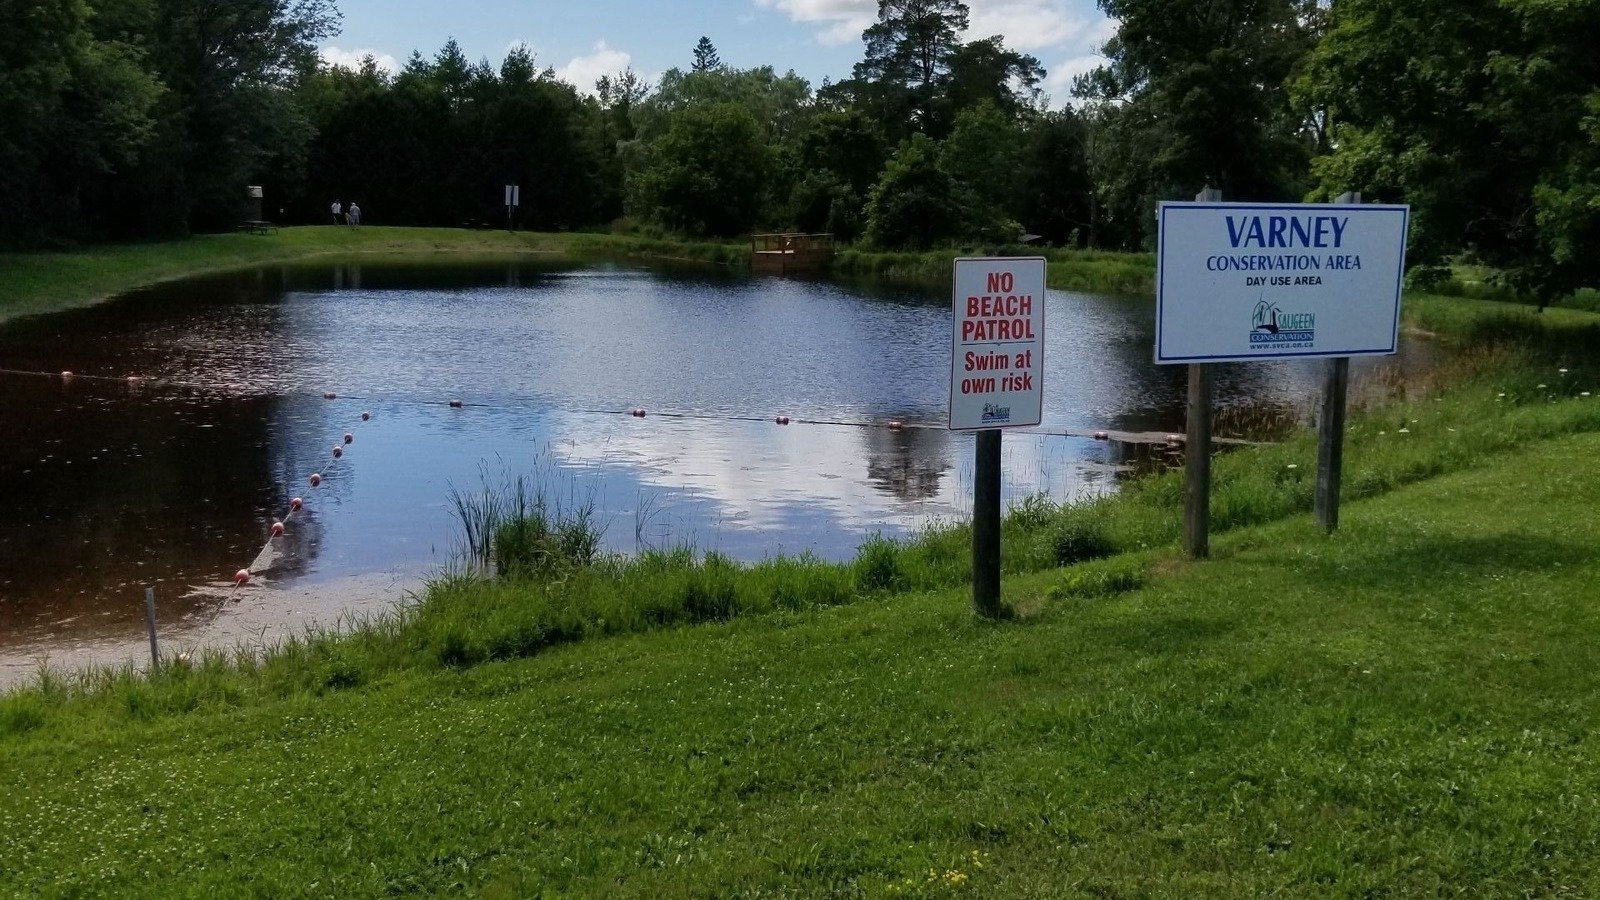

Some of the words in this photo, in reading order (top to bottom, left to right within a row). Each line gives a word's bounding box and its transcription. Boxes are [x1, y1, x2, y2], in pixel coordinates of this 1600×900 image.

[1226, 216, 1348, 247] VARNEY
[1207, 255, 1320, 271] CONSERVATION
[1325, 255, 1361, 270] AREA
[987, 272, 1013, 293] NO
[1246, 276, 1266, 286] DAY
[1270, 276, 1290, 285] USE
[1294, 276, 1322, 285] AREA
[967, 296, 1032, 317] BEACH
[962, 319, 1034, 341] PATROL
[1251, 333, 1313, 342] CONSERVATION
[1250, 342, 1314, 350] www.svca.on.ca
[965, 351, 1008, 371] Swim
[1015, 350, 1031, 368] at
[961, 378, 995, 394] own
[1002, 372, 1032, 391] risk
